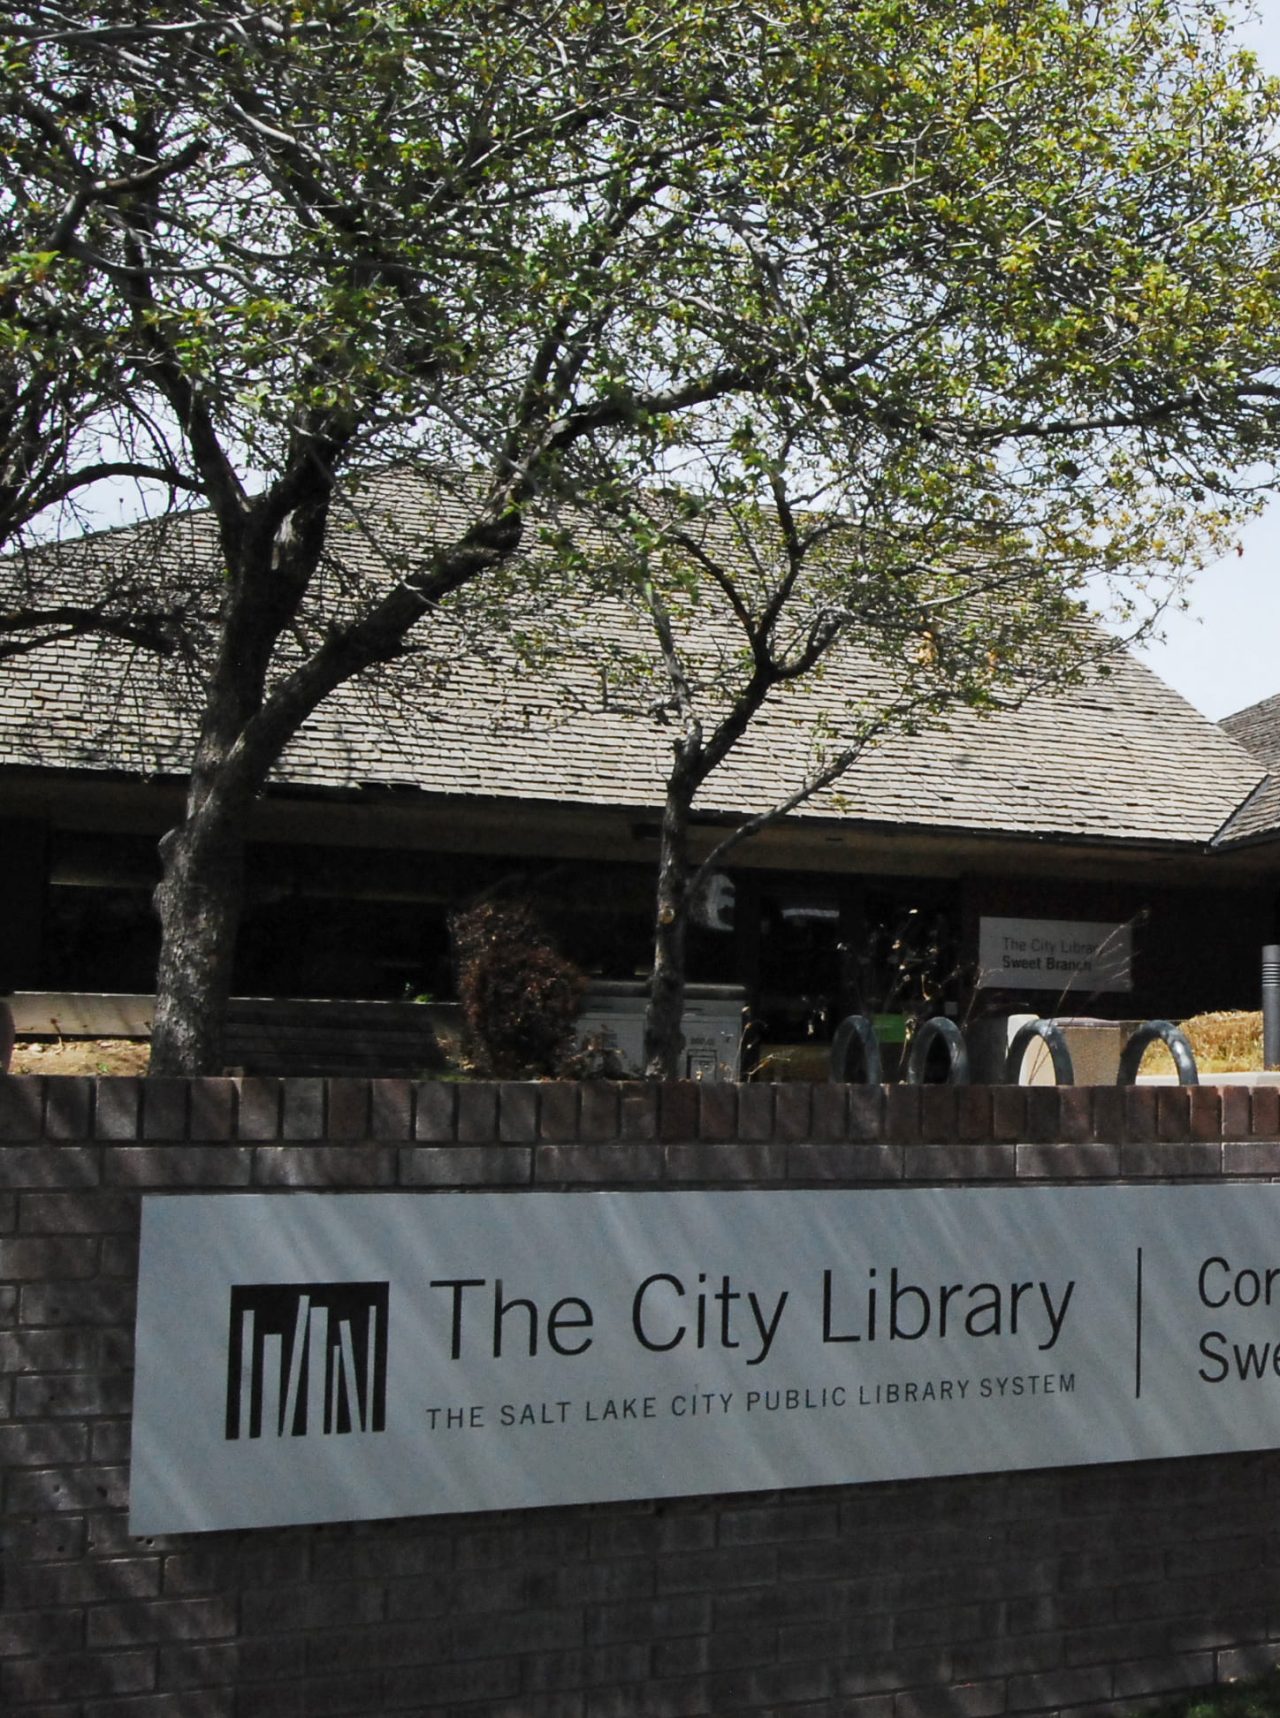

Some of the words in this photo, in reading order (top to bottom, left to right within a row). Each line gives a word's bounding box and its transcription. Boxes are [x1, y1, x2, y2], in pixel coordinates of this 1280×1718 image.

[1002, 955, 1042, 970] Sweet
[1046, 957, 1092, 972] Branch
[1004, 937, 1026, 951] The
[1031, 938, 1056, 954] City
[1061, 939, 1102, 954] Librar
[429, 1278, 594, 1361] The
[631, 1272, 789, 1366] City
[822, 1267, 1076, 1351] Library
[426, 1406, 484, 1430] THE
[500, 1401, 571, 1426] SALT
[585, 1397, 657, 1422] LAKE
[671, 1393, 733, 1417] CITY
[746, 1386, 846, 1412] PUBLIC
[859, 1380, 969, 1405] LIBRARY
[980, 1373, 1075, 1398] SYSTEM
